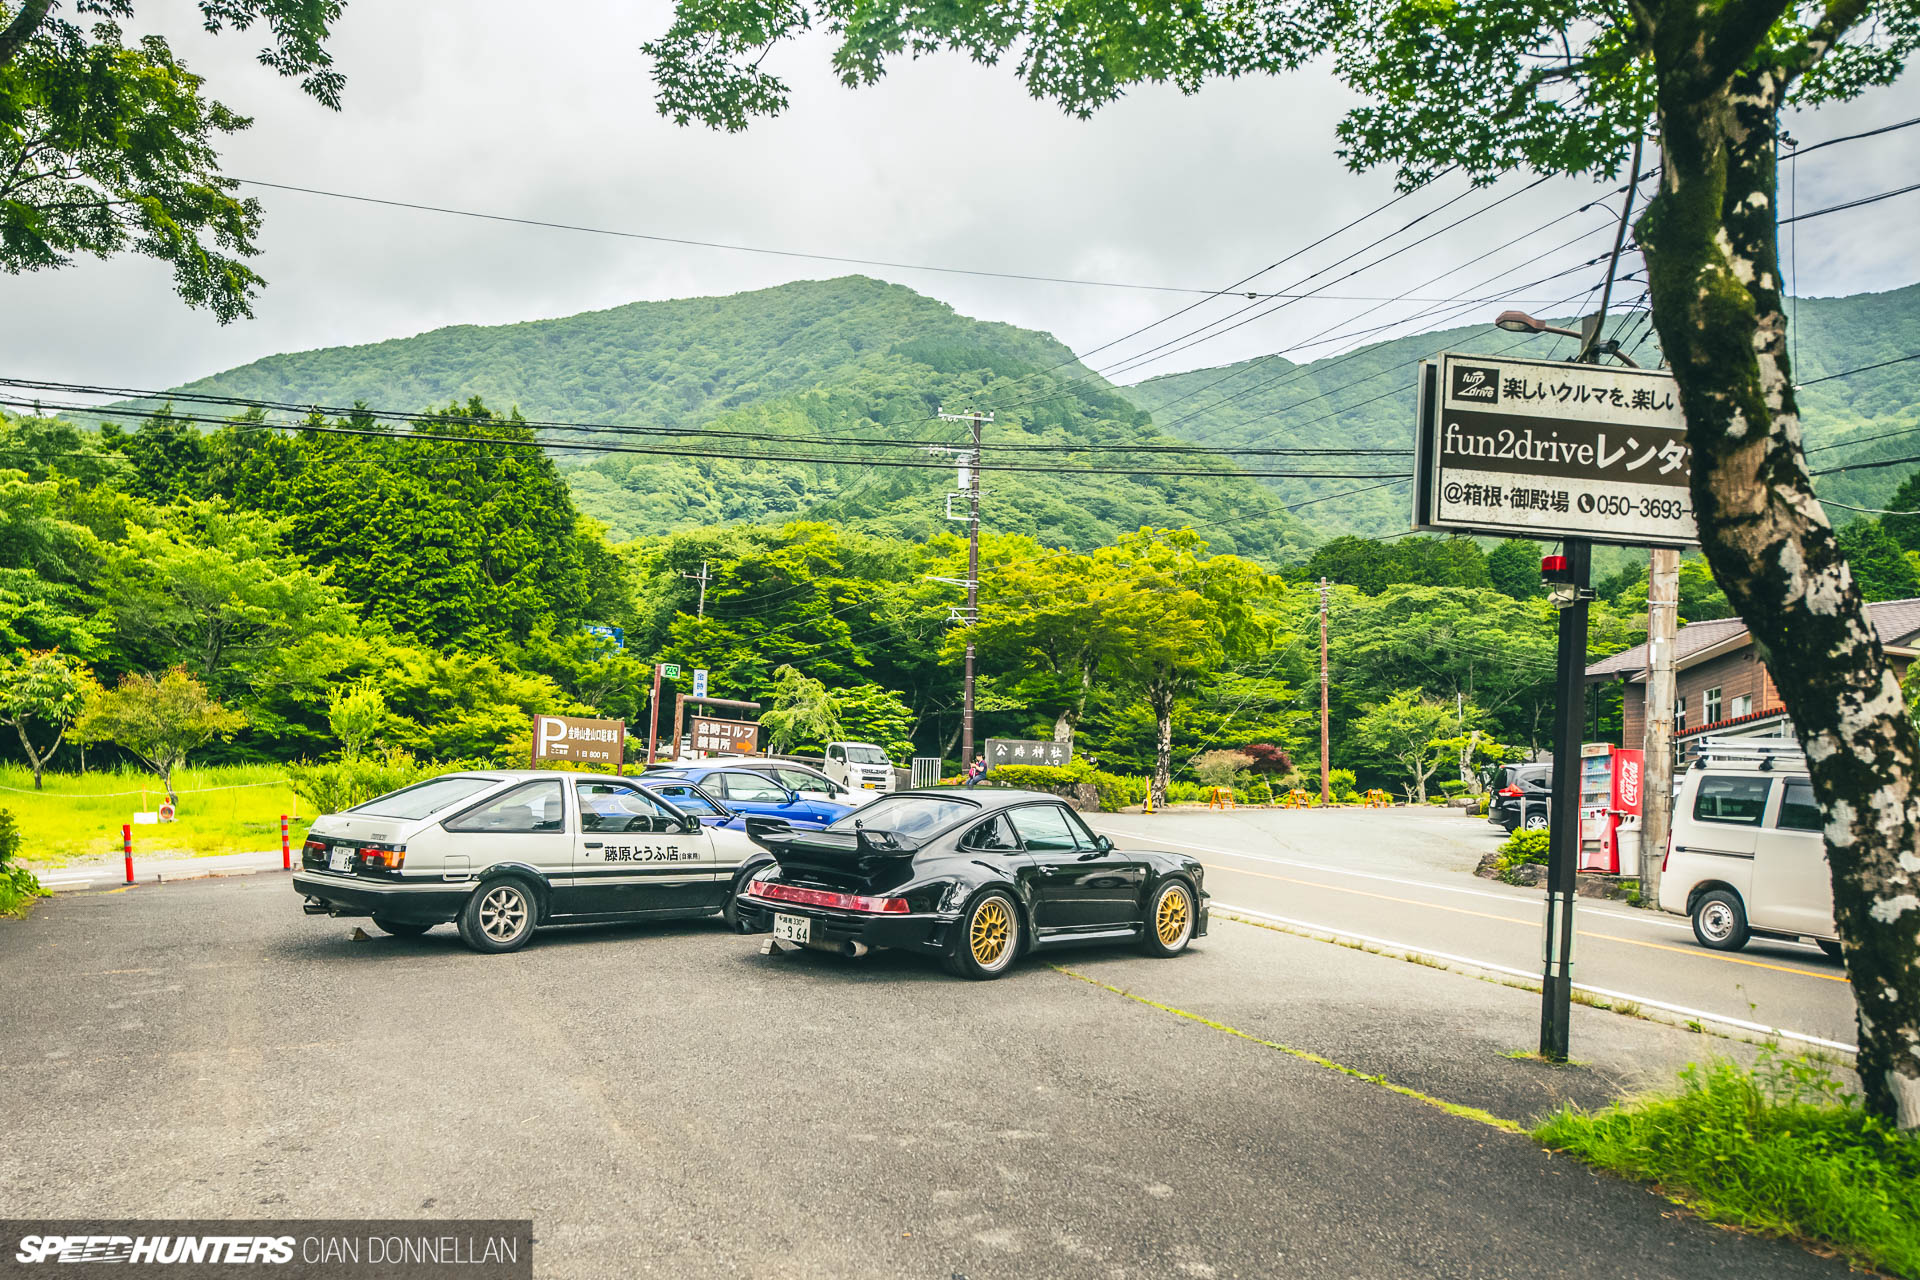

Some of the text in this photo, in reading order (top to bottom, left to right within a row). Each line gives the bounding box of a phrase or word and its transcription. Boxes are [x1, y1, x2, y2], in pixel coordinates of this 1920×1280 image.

[1597, 495, 1697, 520] 050-3693-
[539, 717, 568, 757] P
[698, 721, 755, 738] 金時ゴルフ
